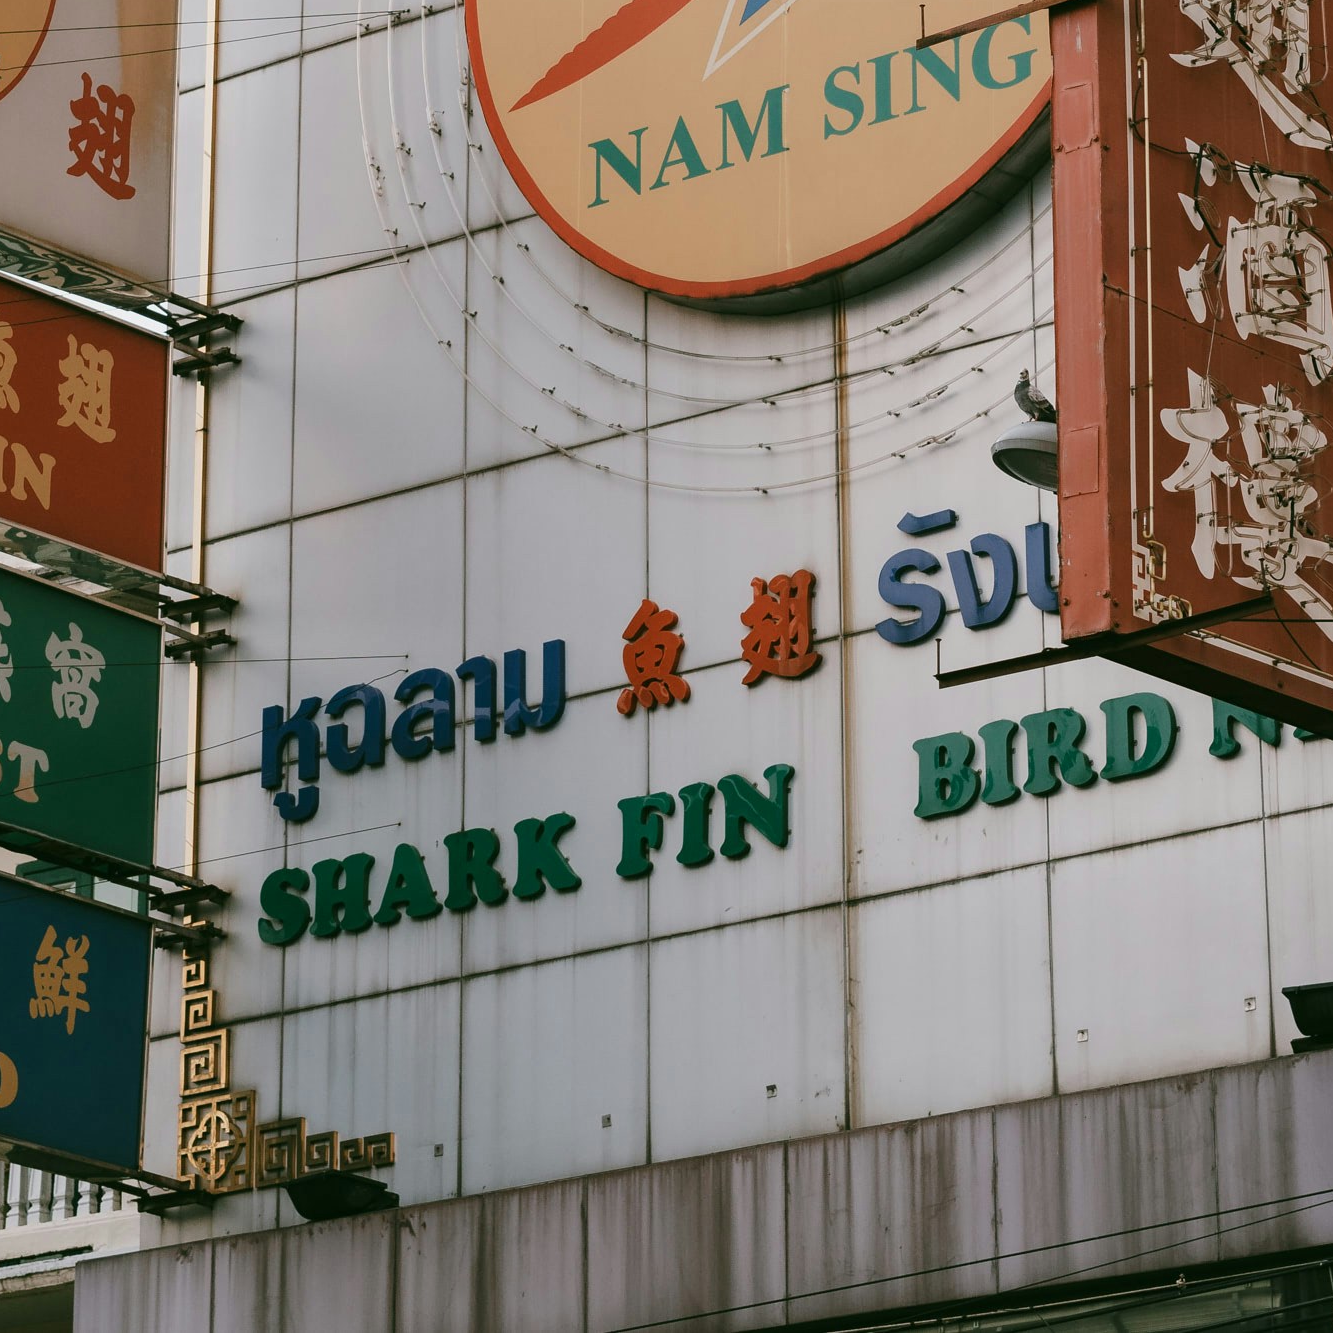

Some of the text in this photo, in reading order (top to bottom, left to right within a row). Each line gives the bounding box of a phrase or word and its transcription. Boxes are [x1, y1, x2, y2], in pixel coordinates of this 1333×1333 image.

[587, 14, 1038, 209] NAM SING
[261, 638, 566, 822] หูฉลาม
[616, 569, 822, 716] 魚翅
[912, 691, 1180, 821] BIRD
[257, 763, 795, 946] SHARK FIN
